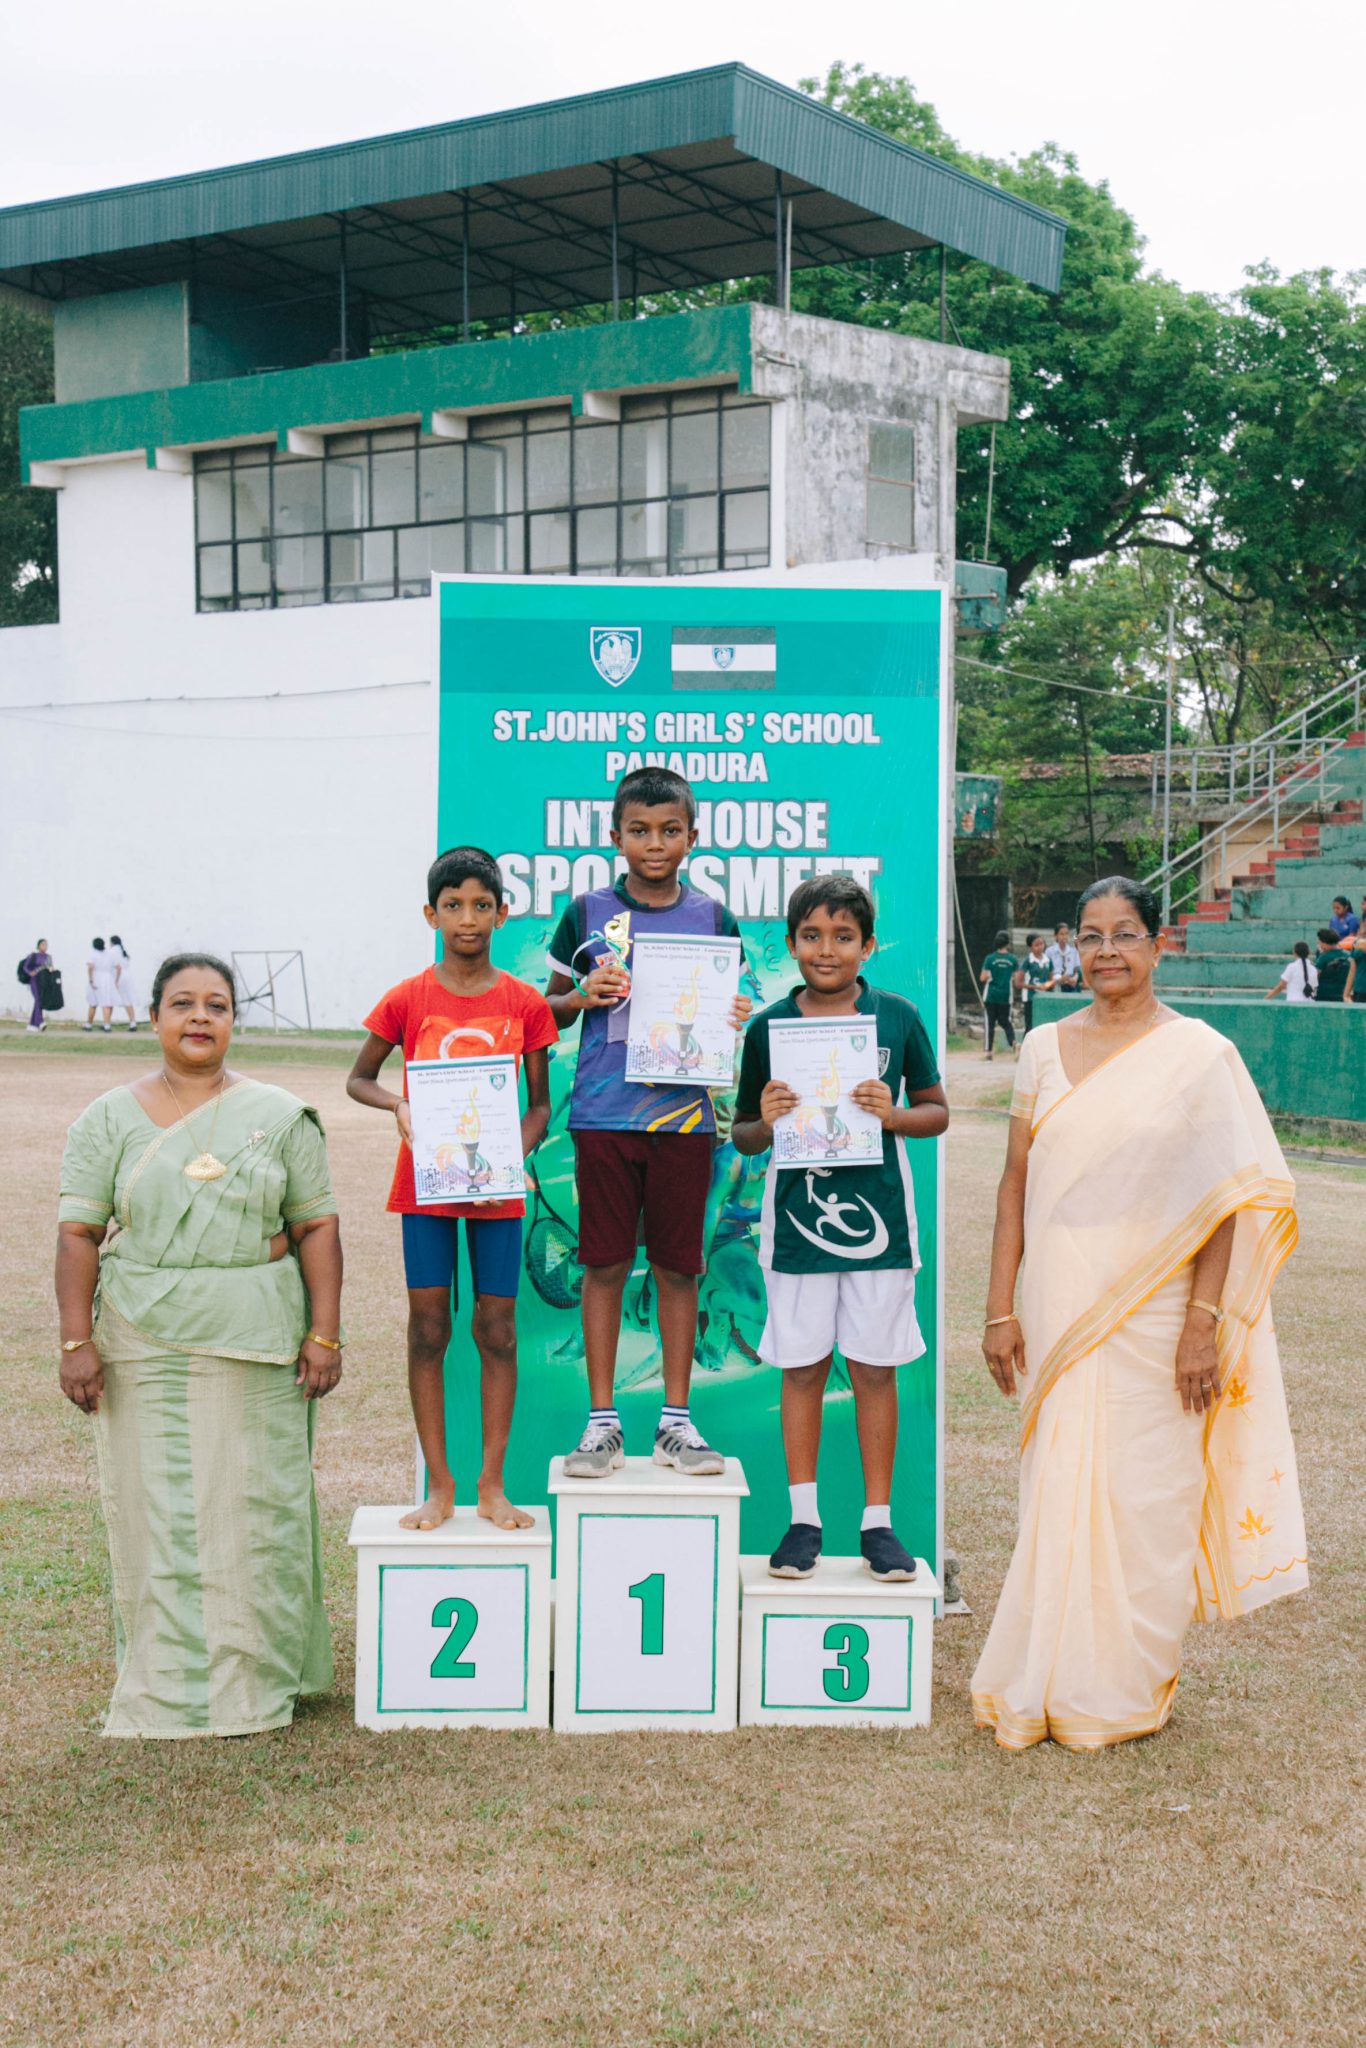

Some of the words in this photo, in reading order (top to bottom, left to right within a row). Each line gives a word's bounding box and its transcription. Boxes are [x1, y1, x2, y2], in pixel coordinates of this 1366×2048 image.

[493, 710, 647, 743] ST.JOHN'S
[655, 711, 757, 744] GIRLS'
[762, 711, 882, 745] SCHOOL
[606, 751, 769, 783] PANADURA
[546, 799, 620, 848] INT
[693, 800, 828, 850] HOUSE
[430, 1597, 479, 1679] 2
[628, 1572, 665, 1655] 1
[822, 1623, 870, 1702] 3
